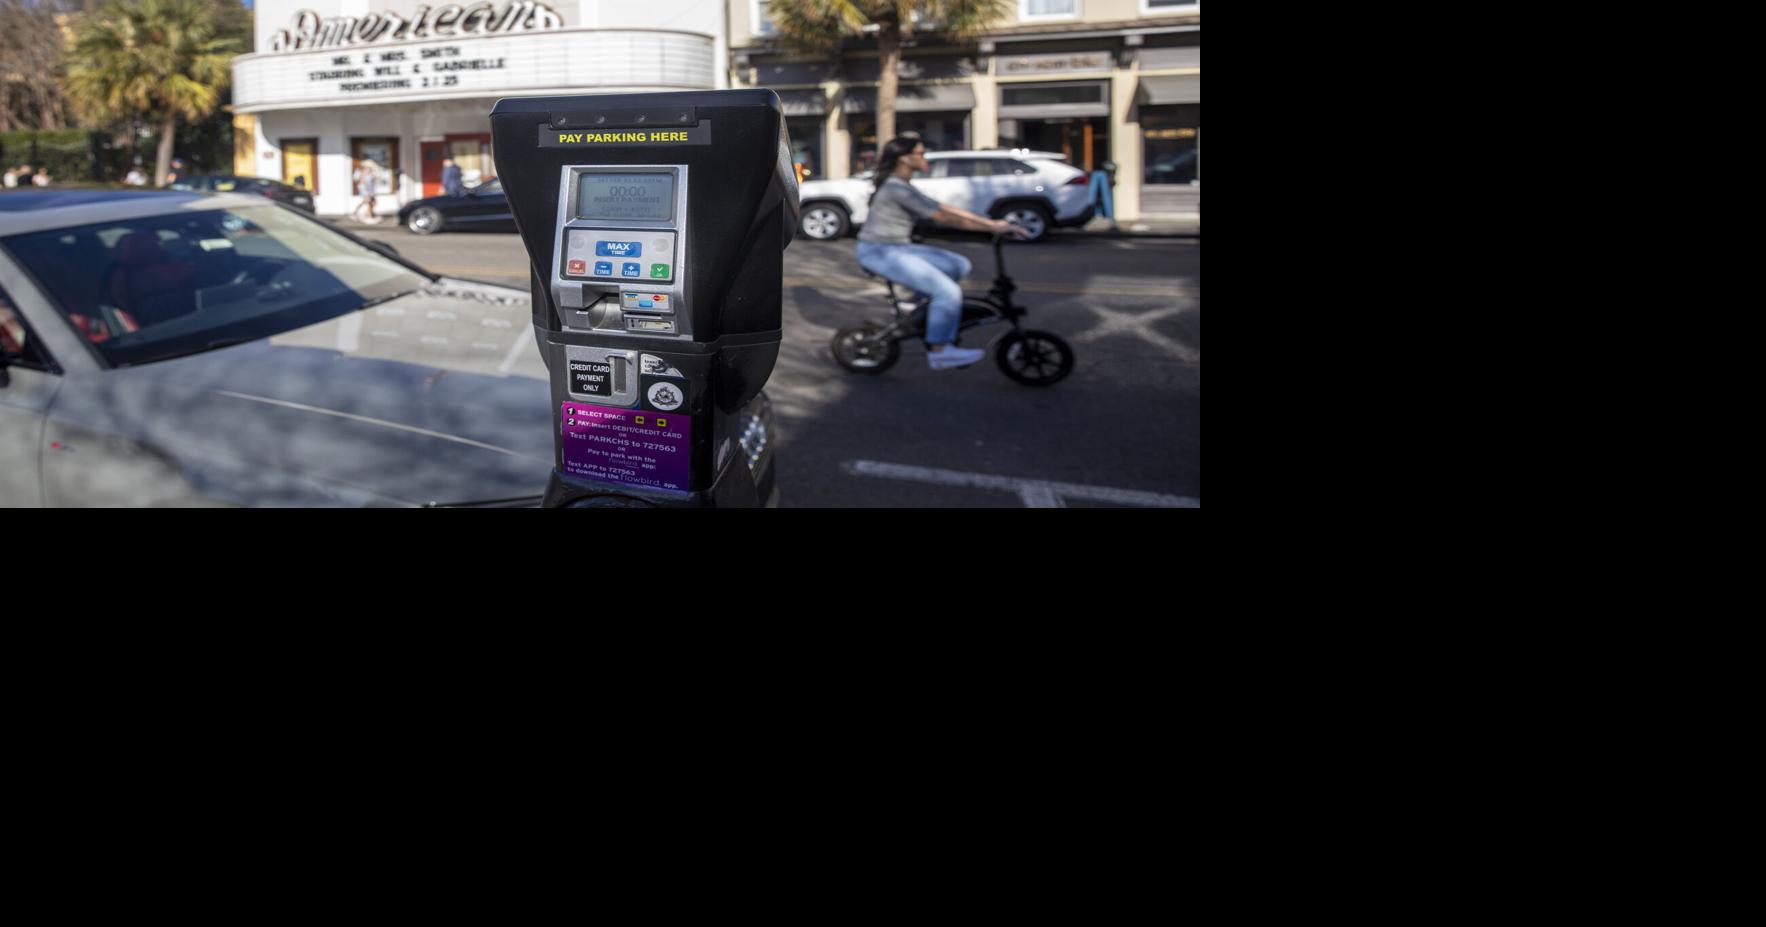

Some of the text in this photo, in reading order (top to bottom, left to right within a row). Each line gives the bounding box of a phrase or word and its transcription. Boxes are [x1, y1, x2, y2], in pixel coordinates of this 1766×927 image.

[559, 131, 688, 143] PAY PARKING HERE
[607, 242, 630, 250] MAX
[570, 363, 610, 373] CREDIT CARD
[577, 374, 604, 382] PAYMENT
[583, 384, 599, 392] ONLY
[577, 409, 602, 418] SELECT
[603, 411, 626, 420] SPACE
[612, 423, 660, 436] DEBIT/CREDIT
[662, 431, 682, 439] CARD
[569, 432, 587, 440] Text
[589, 435, 630, 446] PARKCHS
[643, 442, 676, 452] 727563
[587, 448, 600, 456] Pay
[610, 452, 626, 460] park
[627, 454, 643, 462] with
[575, 469, 606, 477] download
[609, 467, 636, 476] 727563
